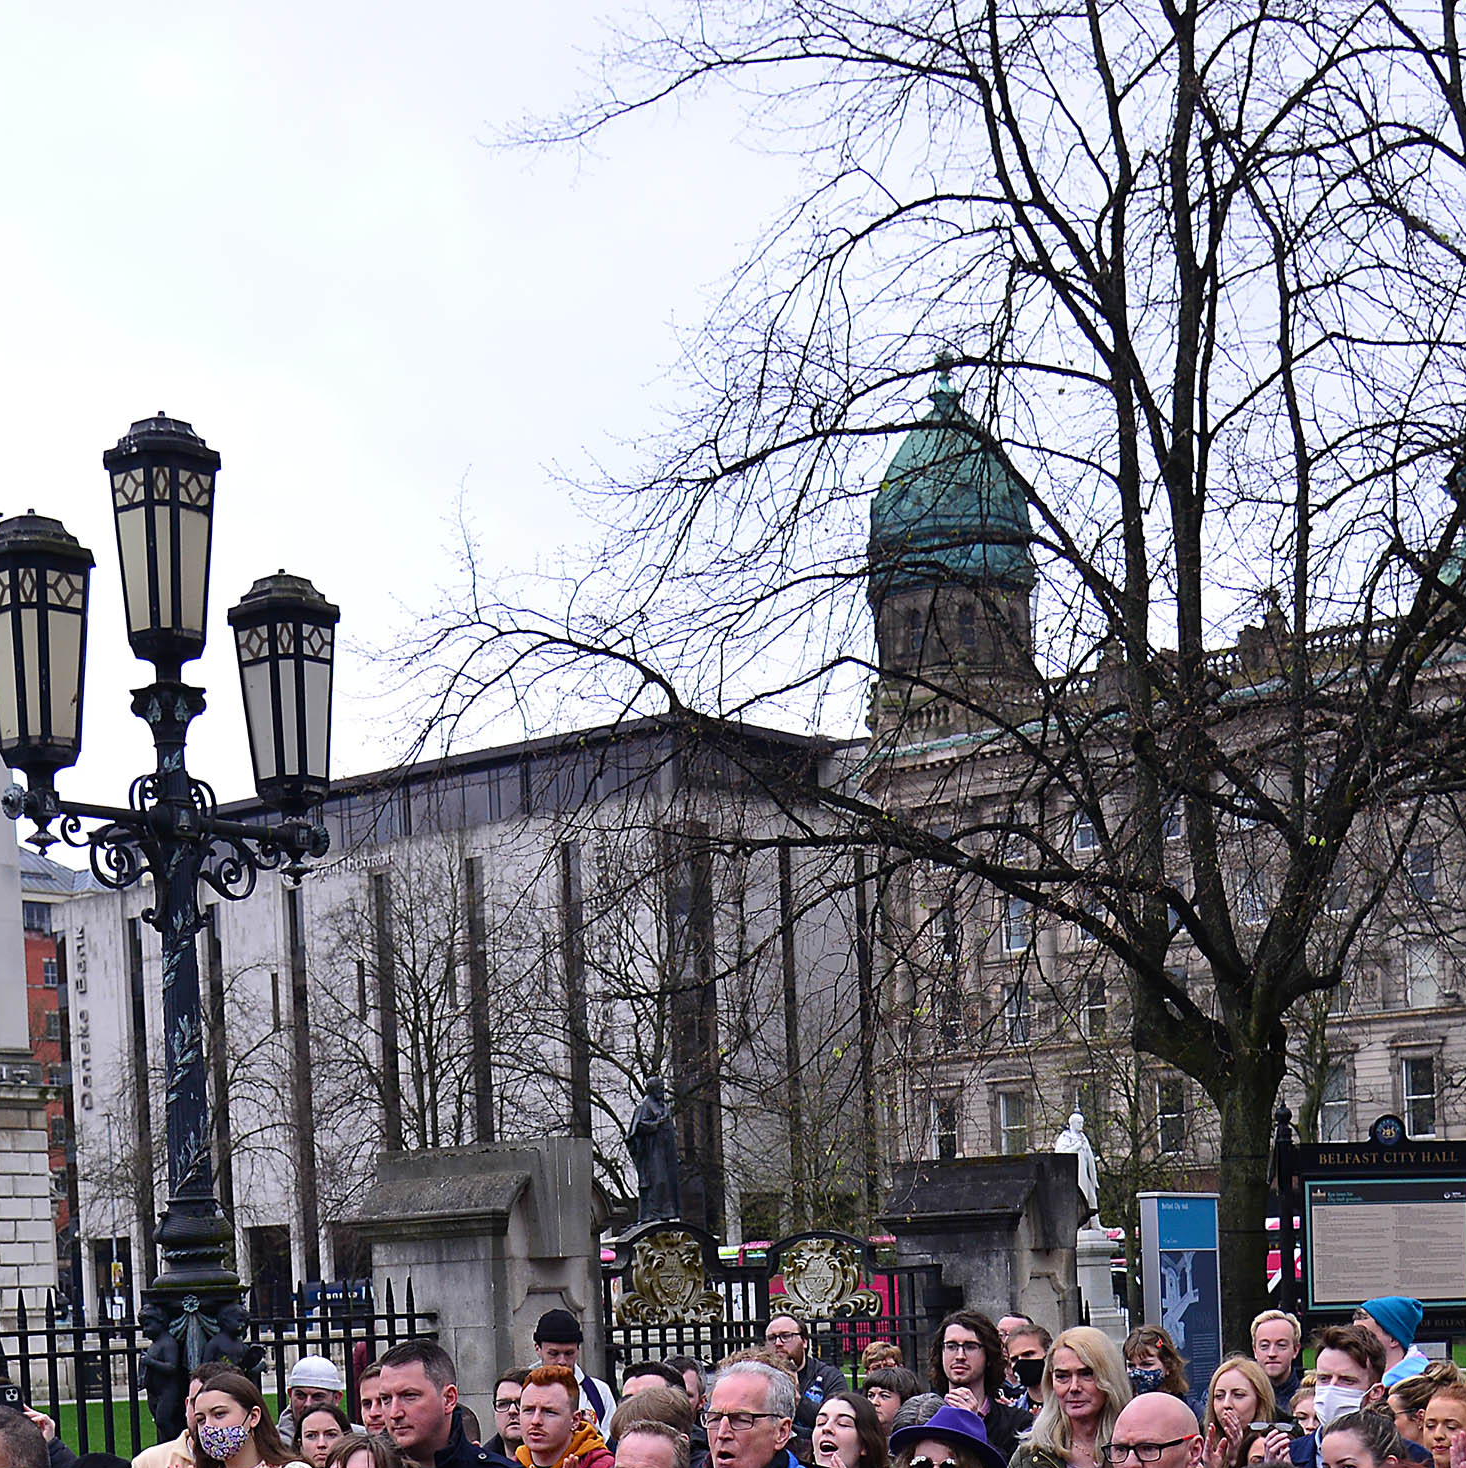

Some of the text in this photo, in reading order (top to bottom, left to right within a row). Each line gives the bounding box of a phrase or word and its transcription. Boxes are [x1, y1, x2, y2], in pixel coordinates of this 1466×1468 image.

[1318, 1151, 1460, 1165] BELFAST CITY HALL
